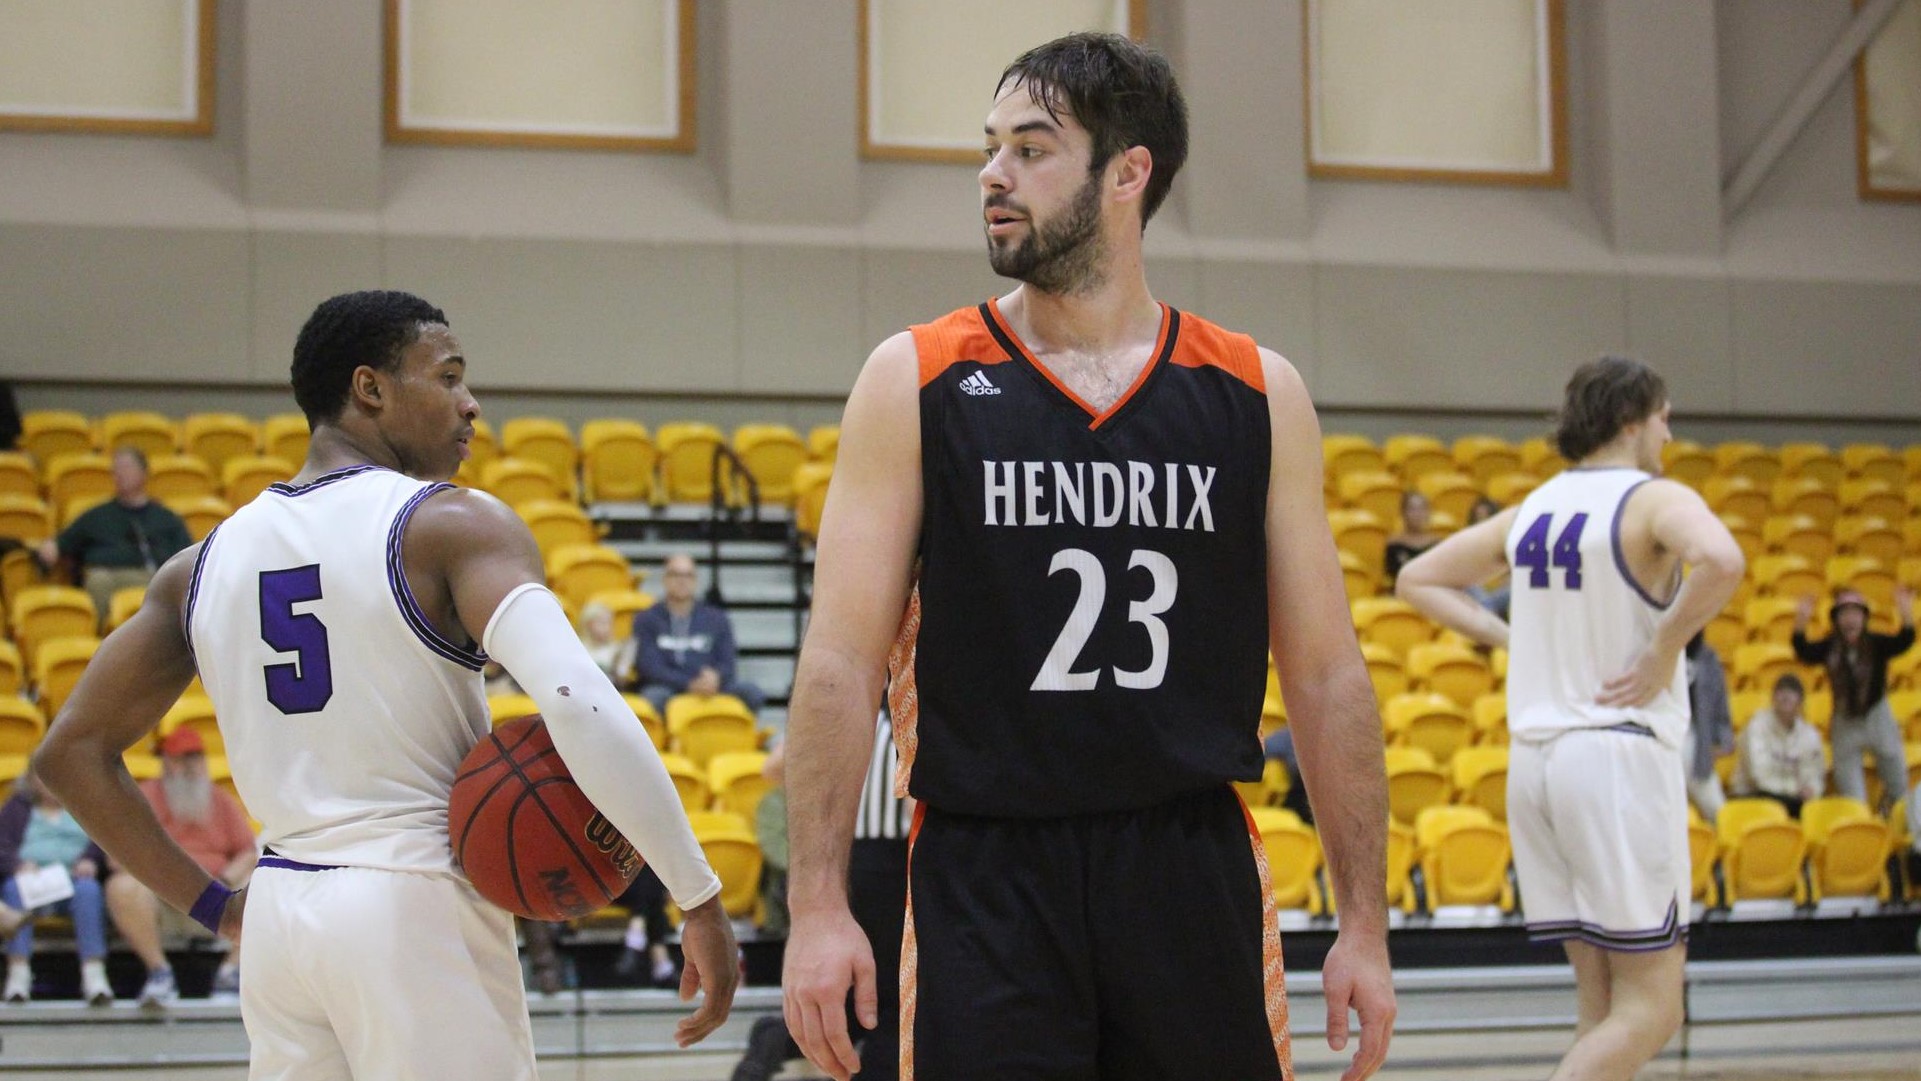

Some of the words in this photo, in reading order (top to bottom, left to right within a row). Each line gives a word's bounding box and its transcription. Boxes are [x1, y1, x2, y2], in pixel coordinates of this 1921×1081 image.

[959, 382, 1002, 396] adidas
[982, 459, 1217, 533] HENDRIX
[1515, 512, 1589, 590] 44
[259, 563, 334, 715] 5
[1029, 548, 1179, 692] 23
